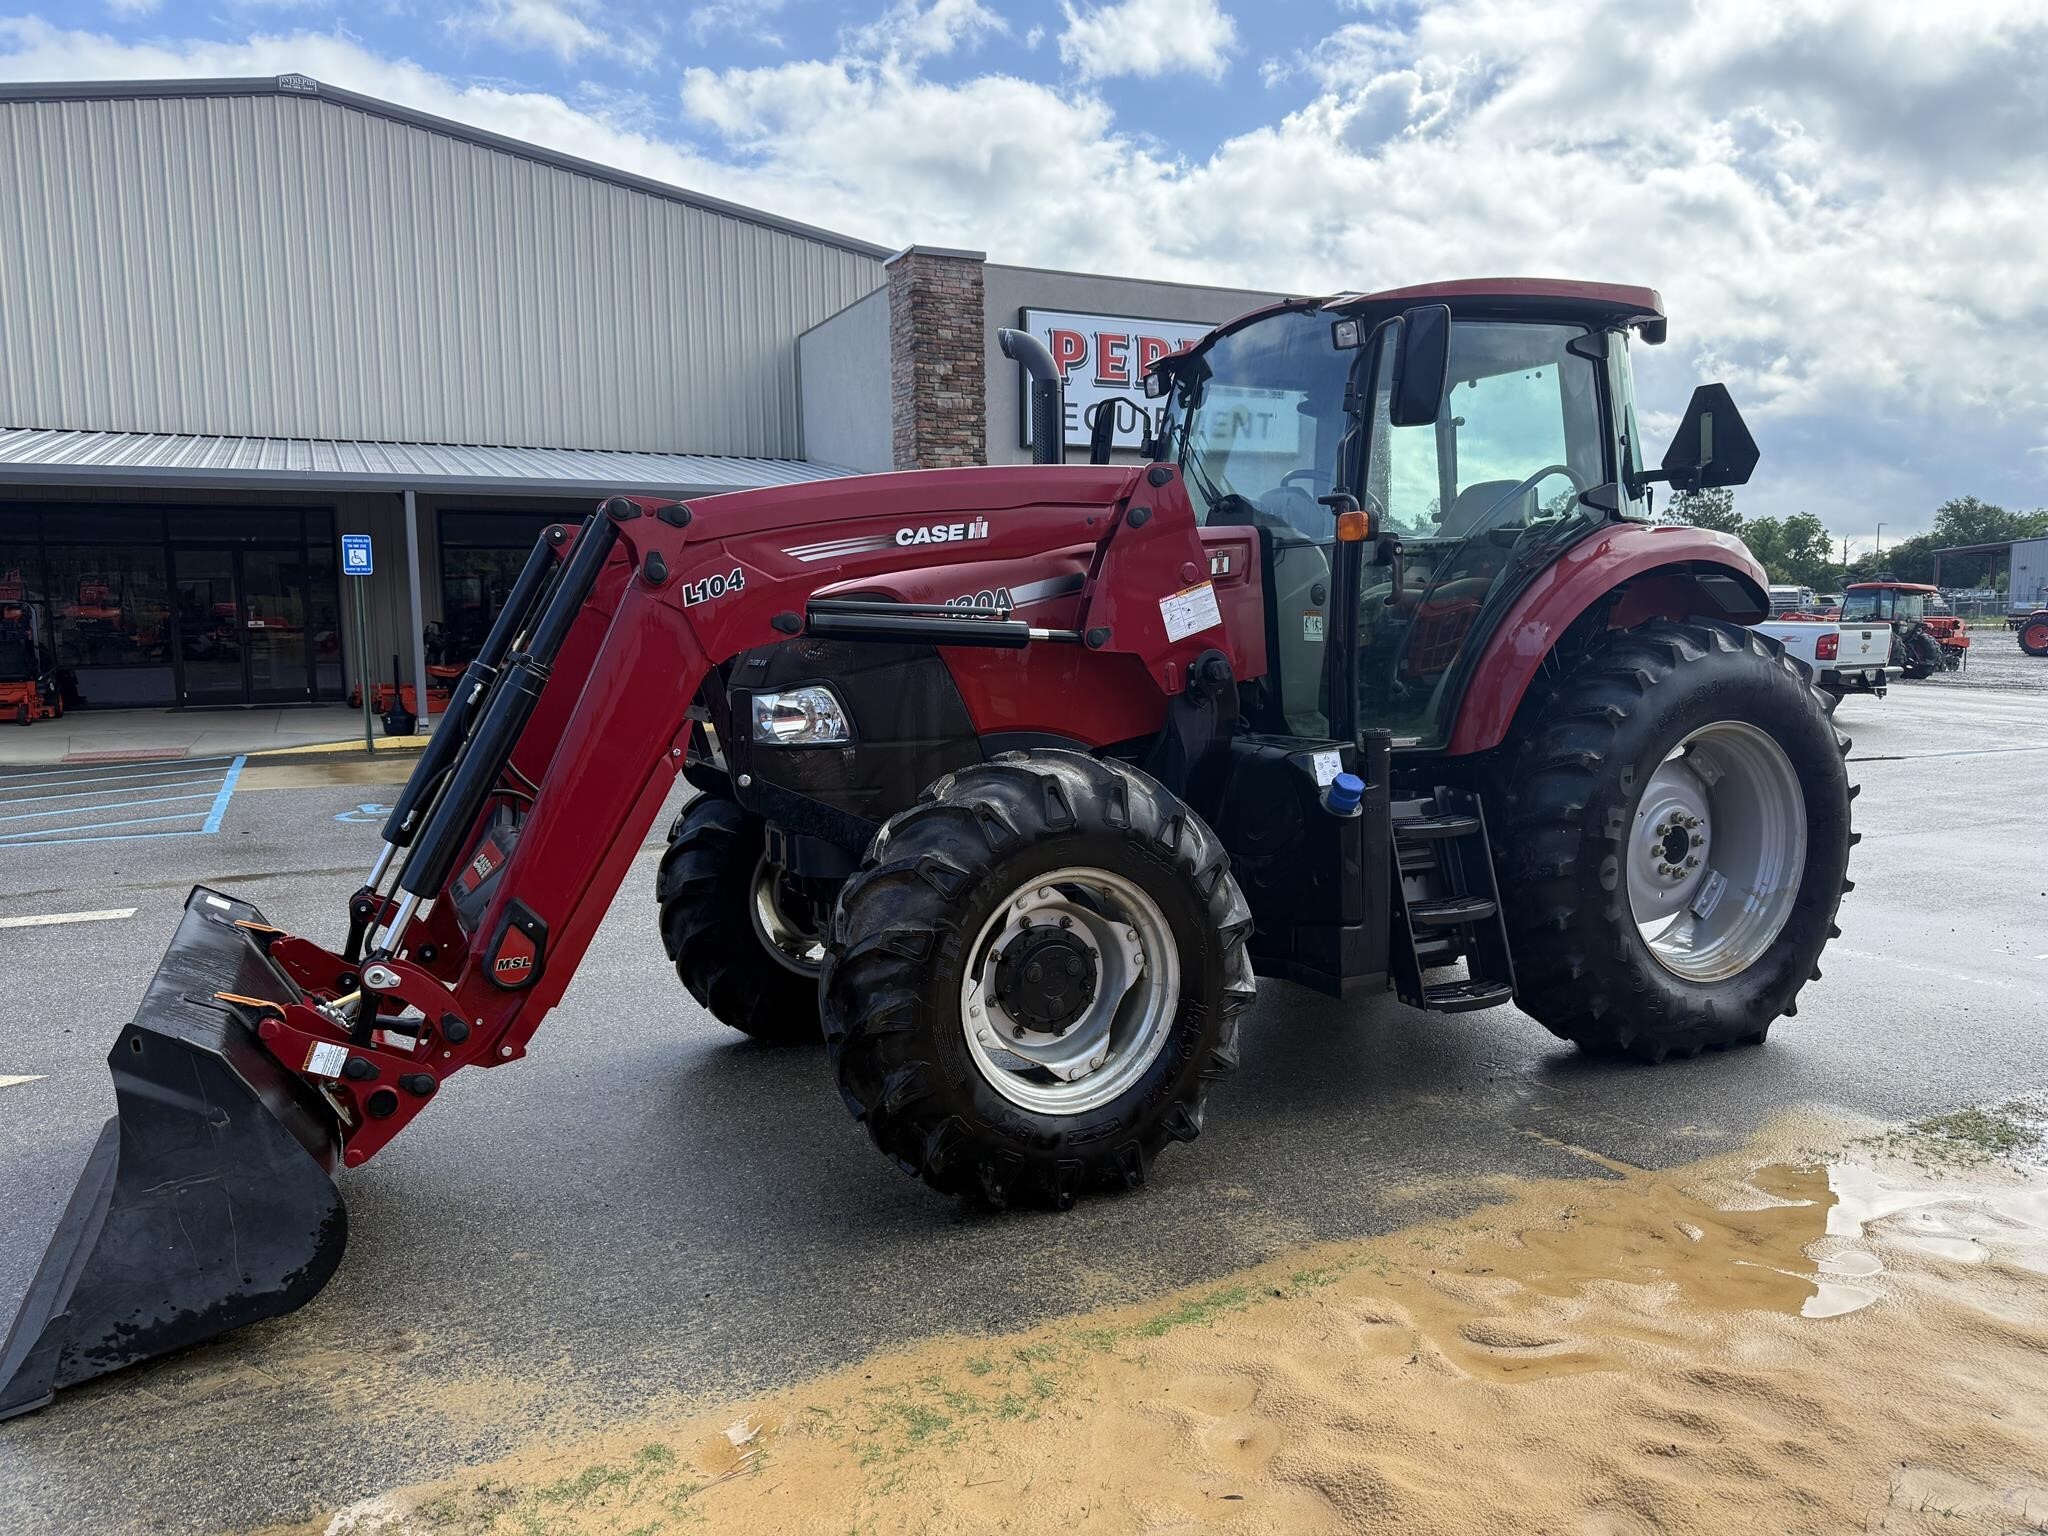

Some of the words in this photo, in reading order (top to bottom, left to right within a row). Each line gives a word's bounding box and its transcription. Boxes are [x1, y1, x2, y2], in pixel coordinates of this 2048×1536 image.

[895, 524, 964, 546] CASE
[683, 567, 745, 608] L104
[496, 957, 532, 971] MSL
